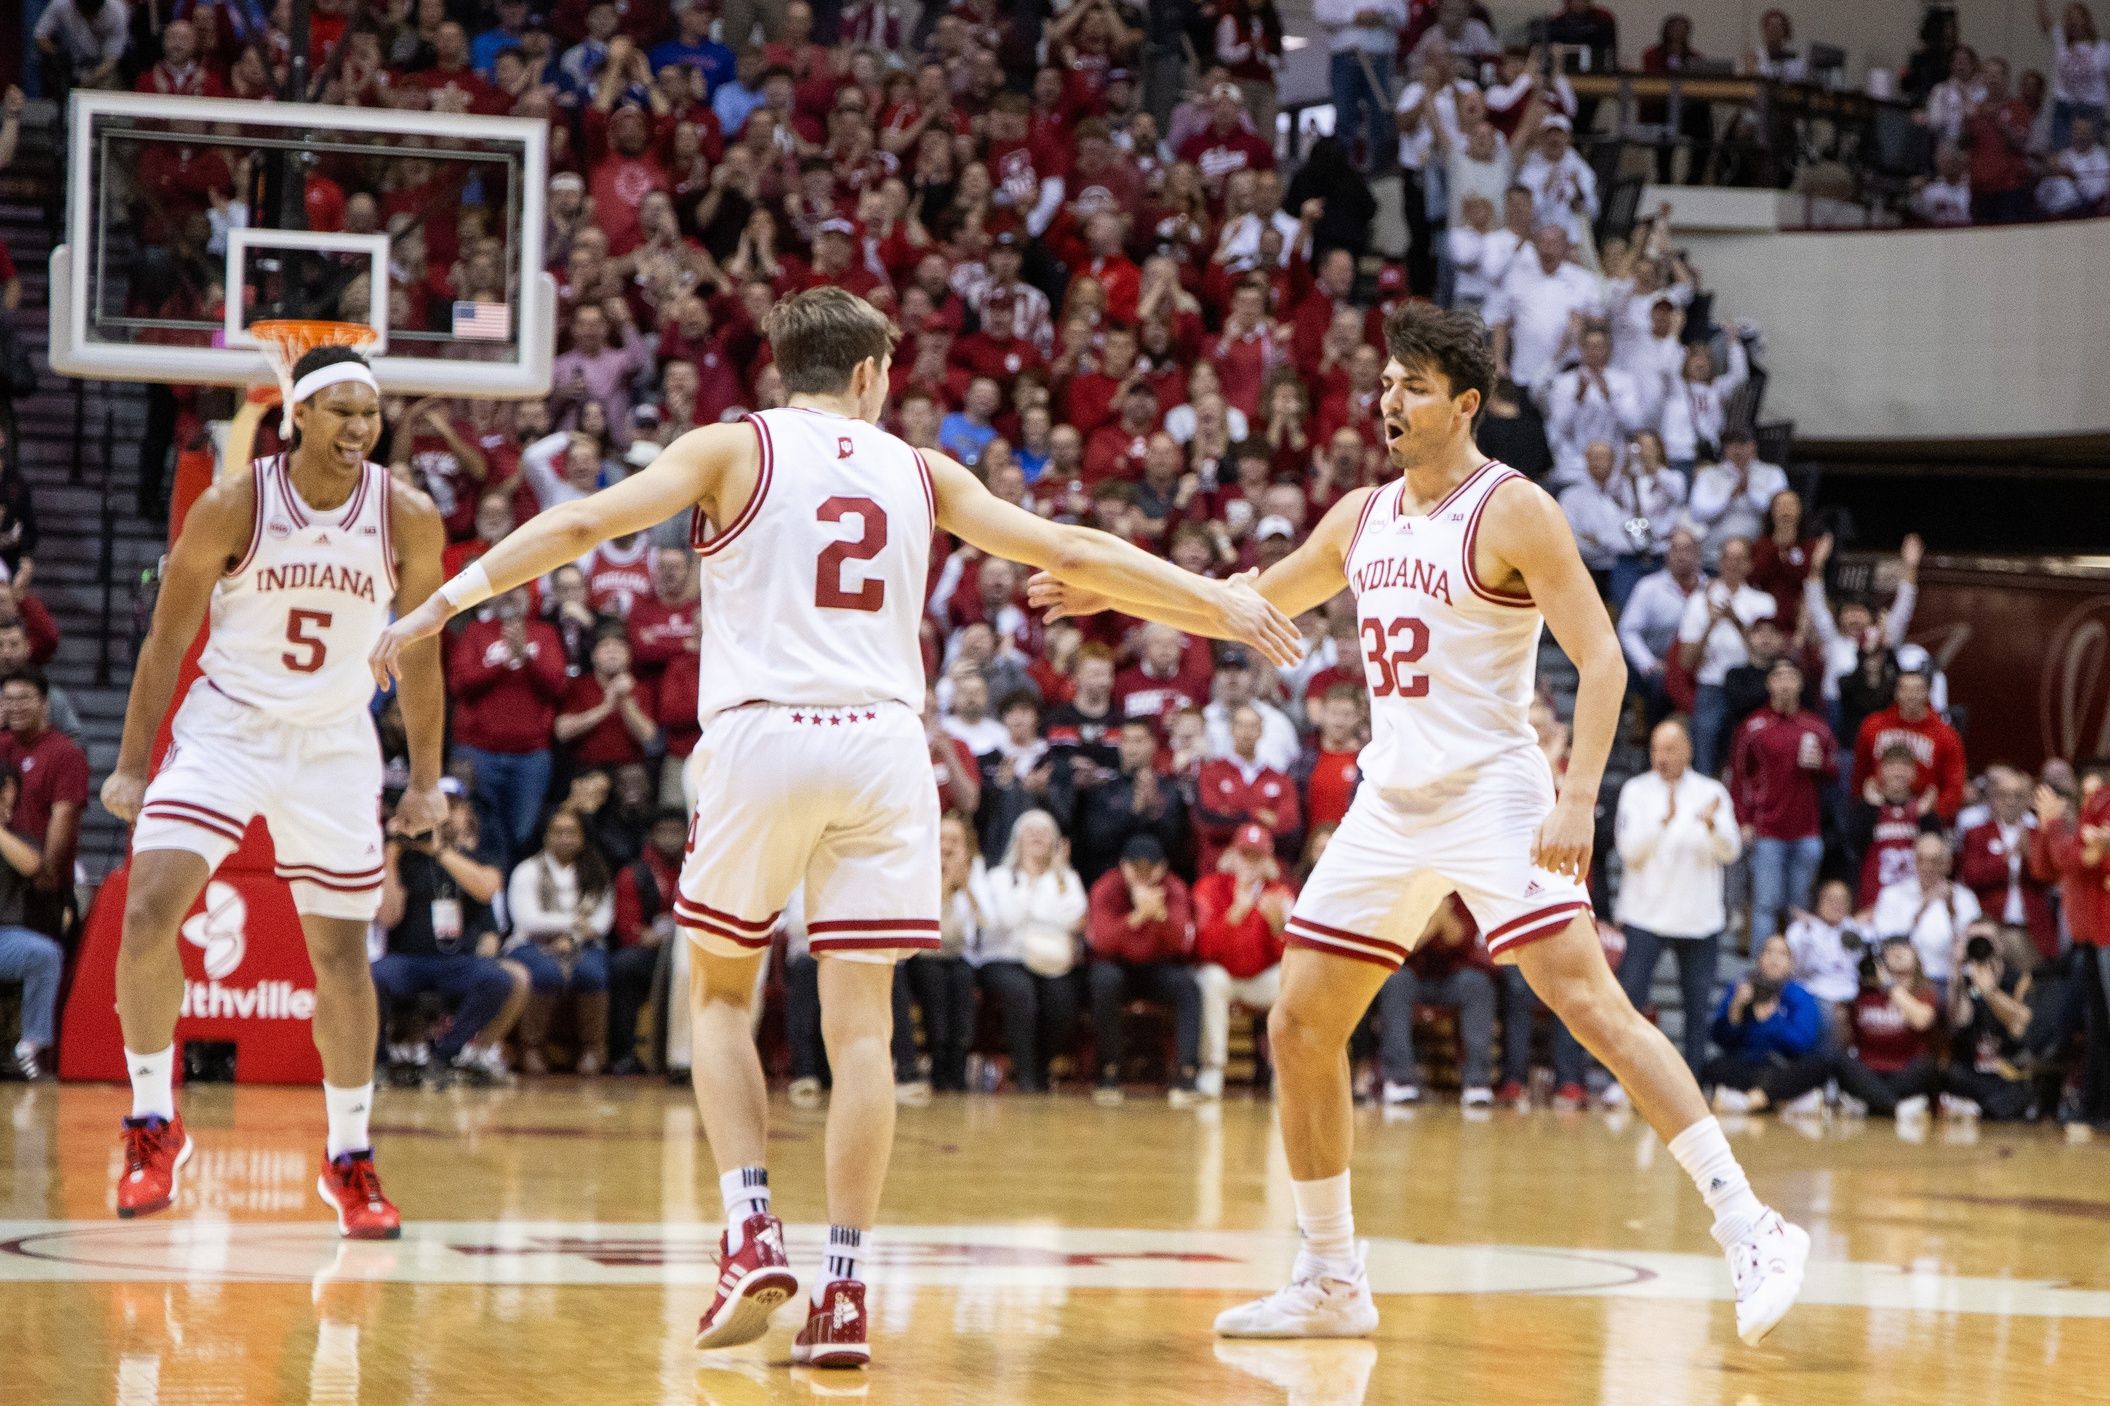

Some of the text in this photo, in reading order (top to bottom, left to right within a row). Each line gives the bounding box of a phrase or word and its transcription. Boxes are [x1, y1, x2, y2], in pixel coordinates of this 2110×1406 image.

[256, 562, 375, 603] INDIANA
[815, 495, 888, 612] 2
[281, 607, 333, 673] 5
[1361, 617, 1430, 697] 32
[180, 979, 317, 1020] ithville
